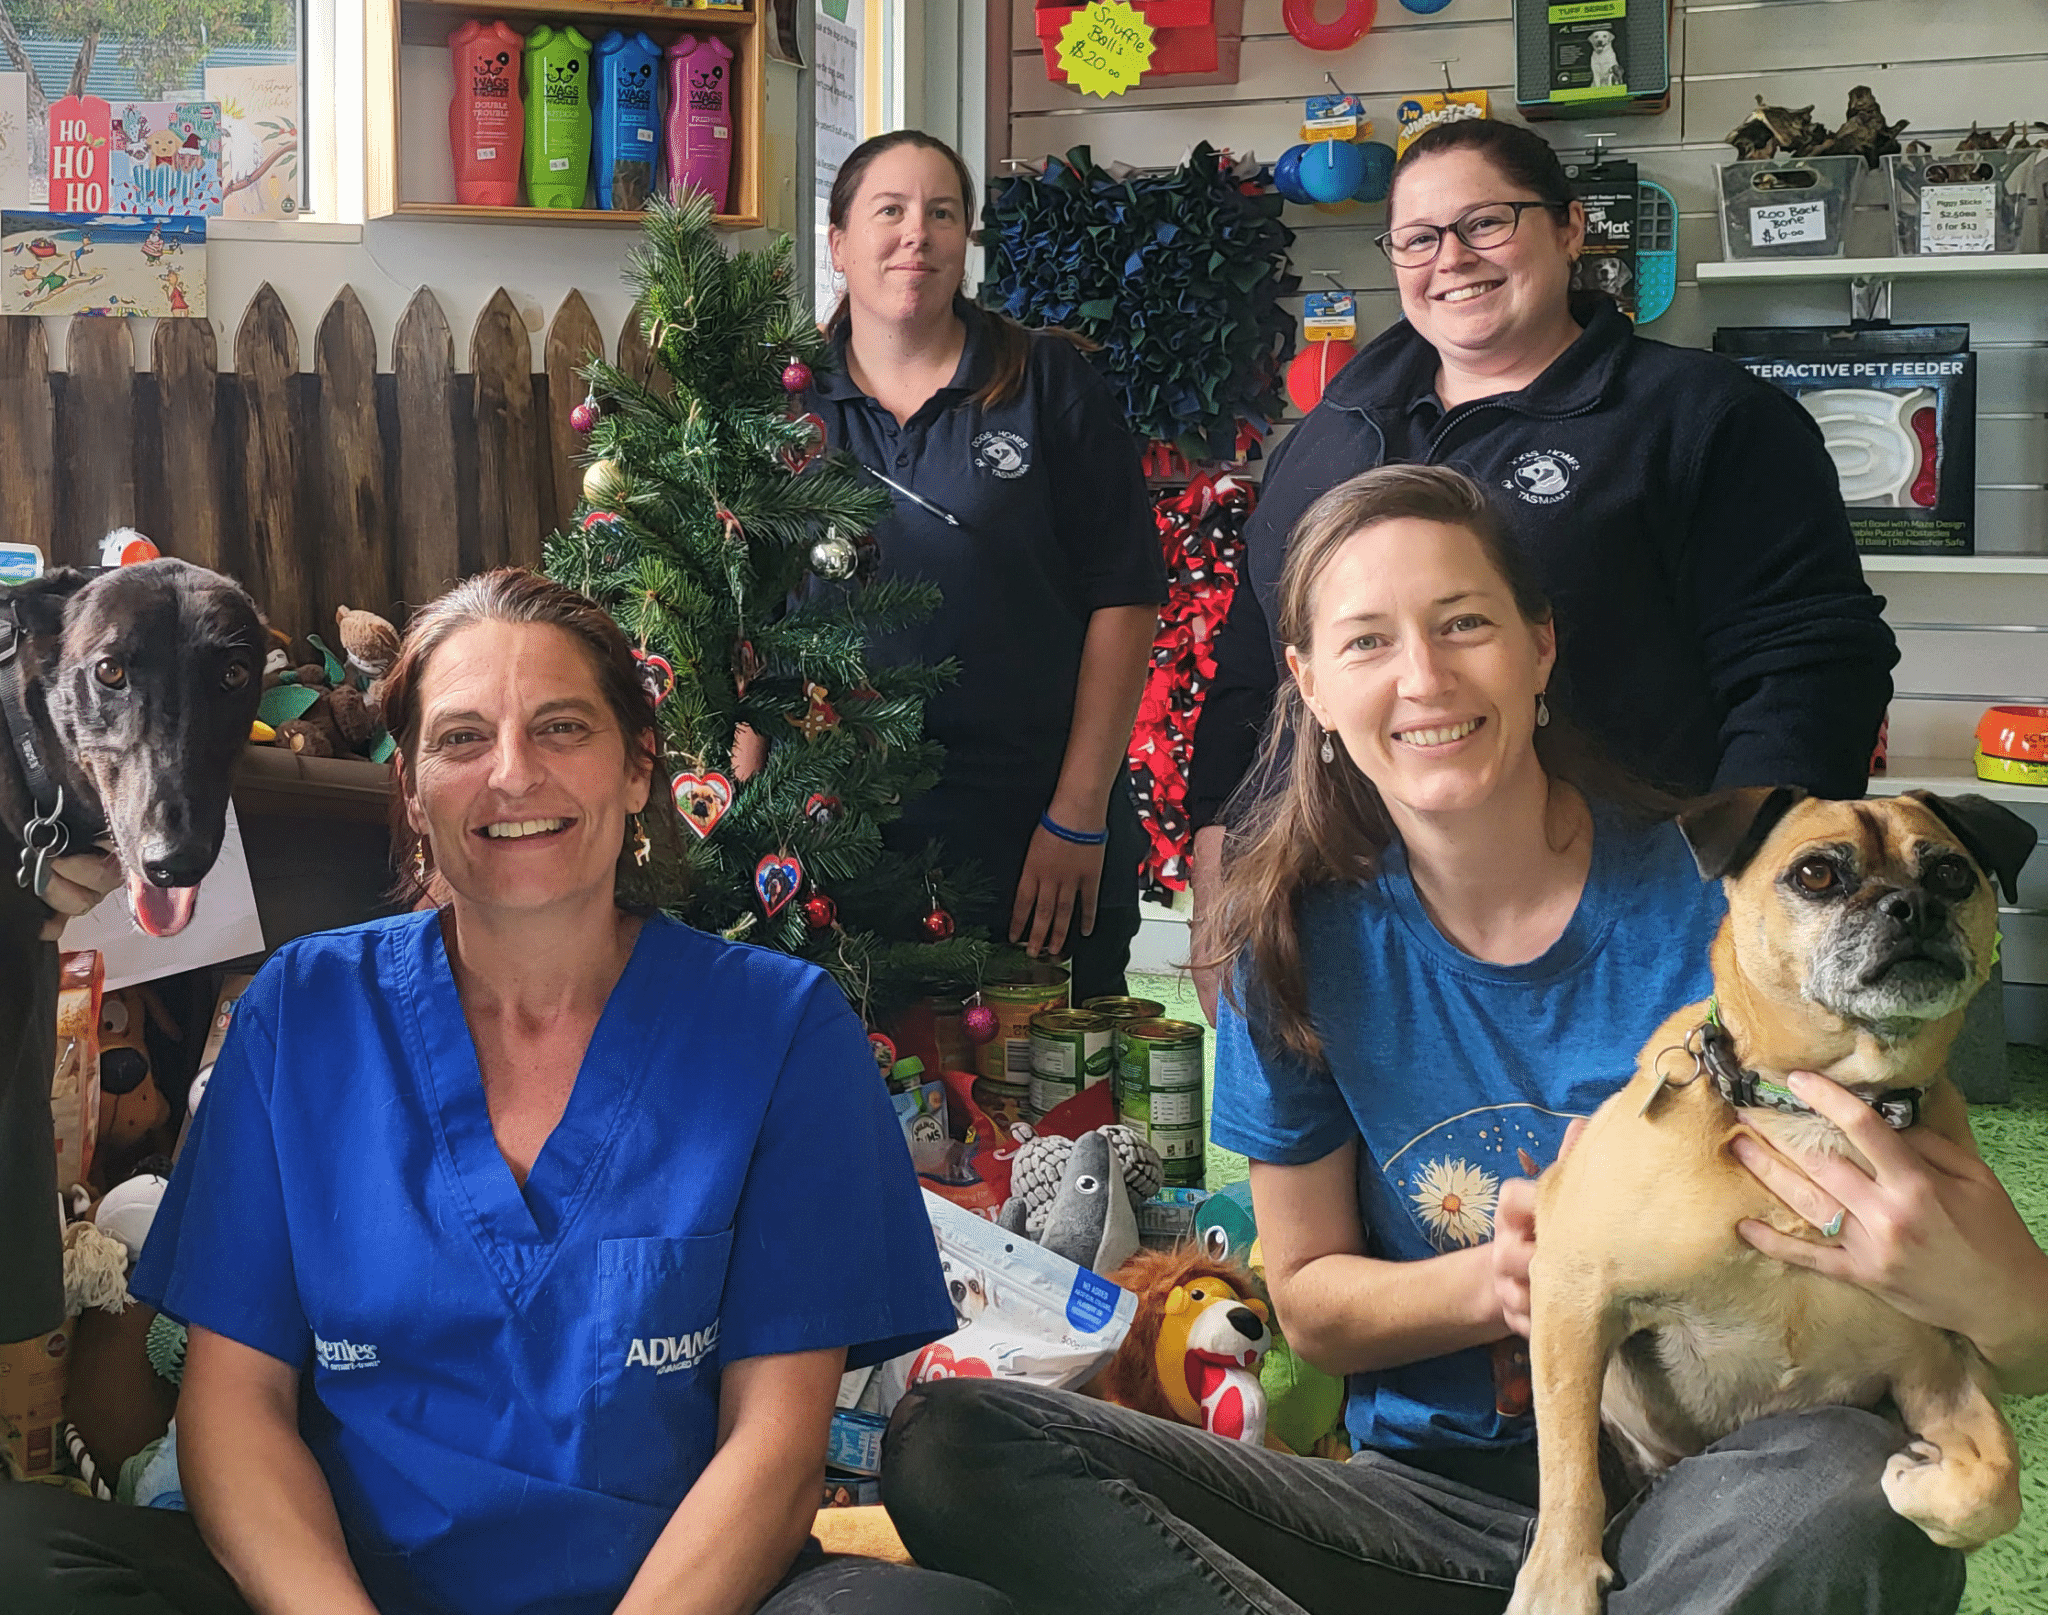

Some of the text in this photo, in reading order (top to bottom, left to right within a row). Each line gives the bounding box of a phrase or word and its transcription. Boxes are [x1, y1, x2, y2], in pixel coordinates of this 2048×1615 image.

[1094, 7, 1144, 53] Snuffle
[60, 119, 87, 142] HO
[53, 145, 94, 179] HO
[66, 183, 102, 212] HO
[1945, 222, 1958, 230] for
[1745, 362, 1963, 377] TERACTIVE PET FEEDER
[625, 1316, 719, 1367] ADVANC
